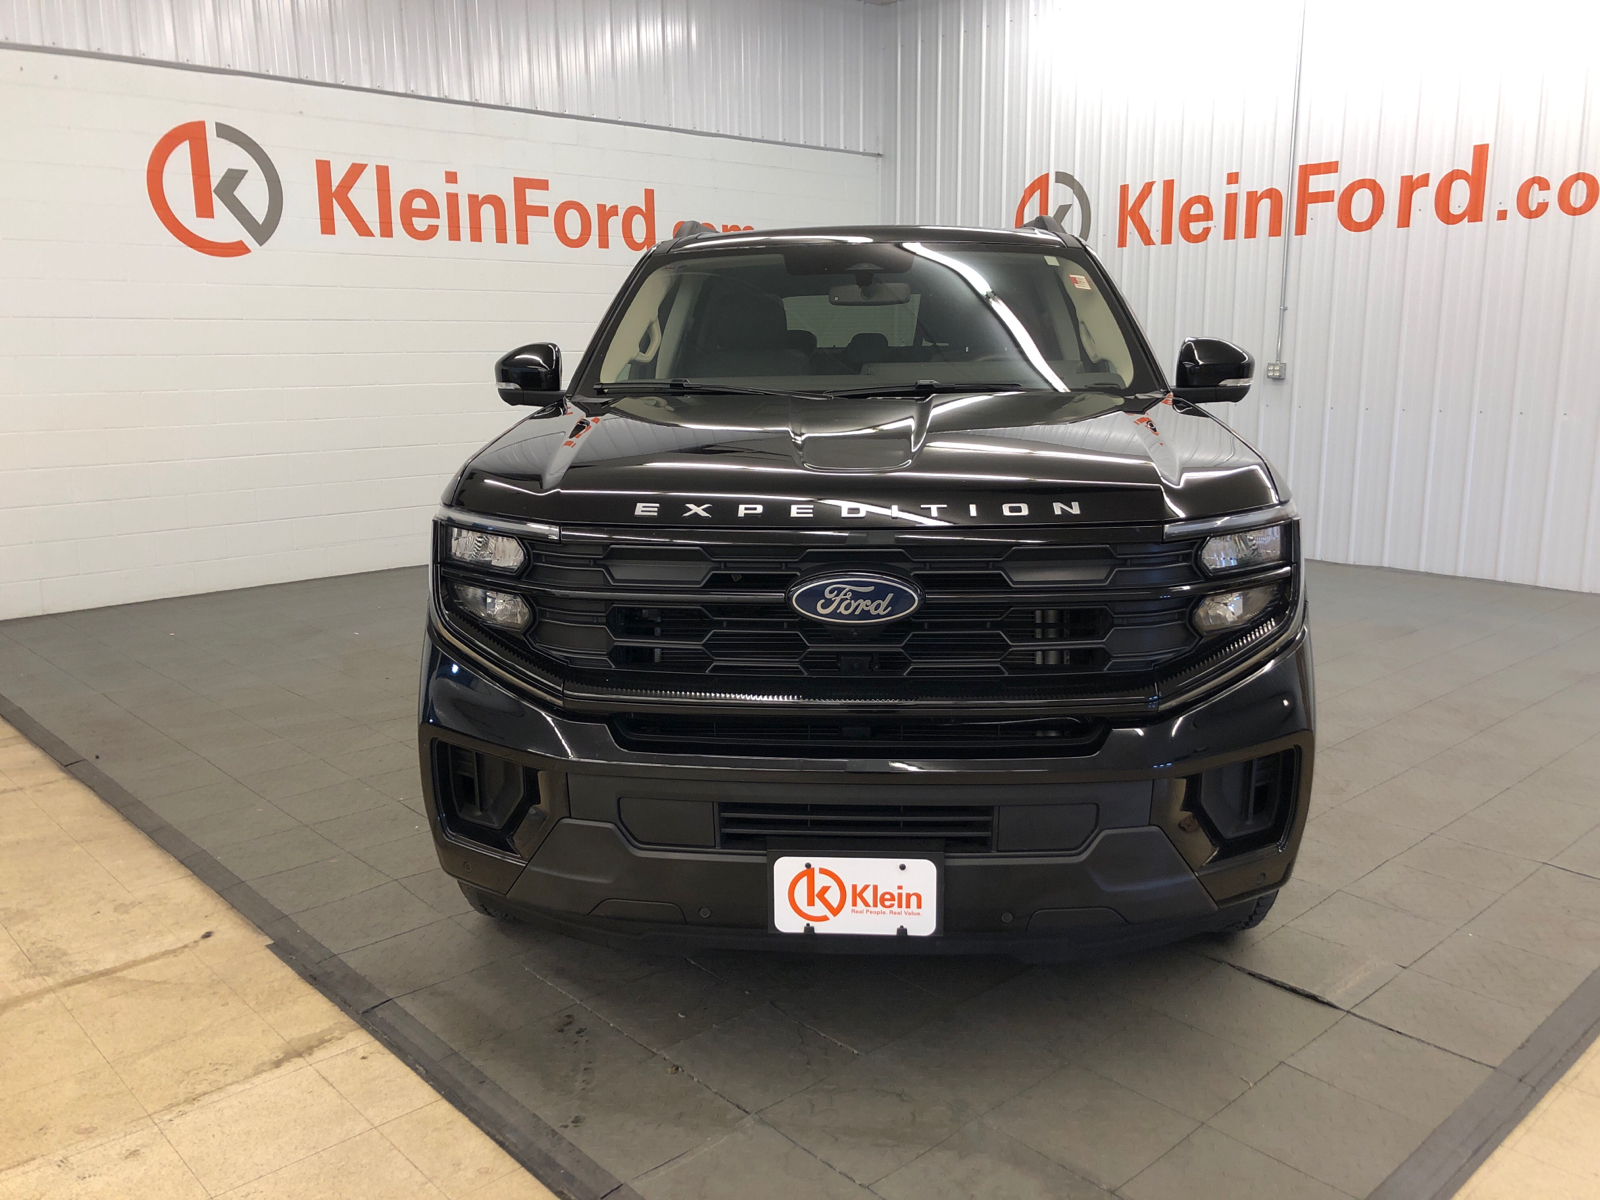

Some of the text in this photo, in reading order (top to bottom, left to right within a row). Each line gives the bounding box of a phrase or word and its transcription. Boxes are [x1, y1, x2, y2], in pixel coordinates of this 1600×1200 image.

[315, 158, 755, 252] KleinFord
[1117, 143, 1600, 248] KleinFord.co
[634, 502, 1080, 518] EXPEDITION
[816, 584, 894, 615] Ford
[851, 884, 922, 909] Klein
